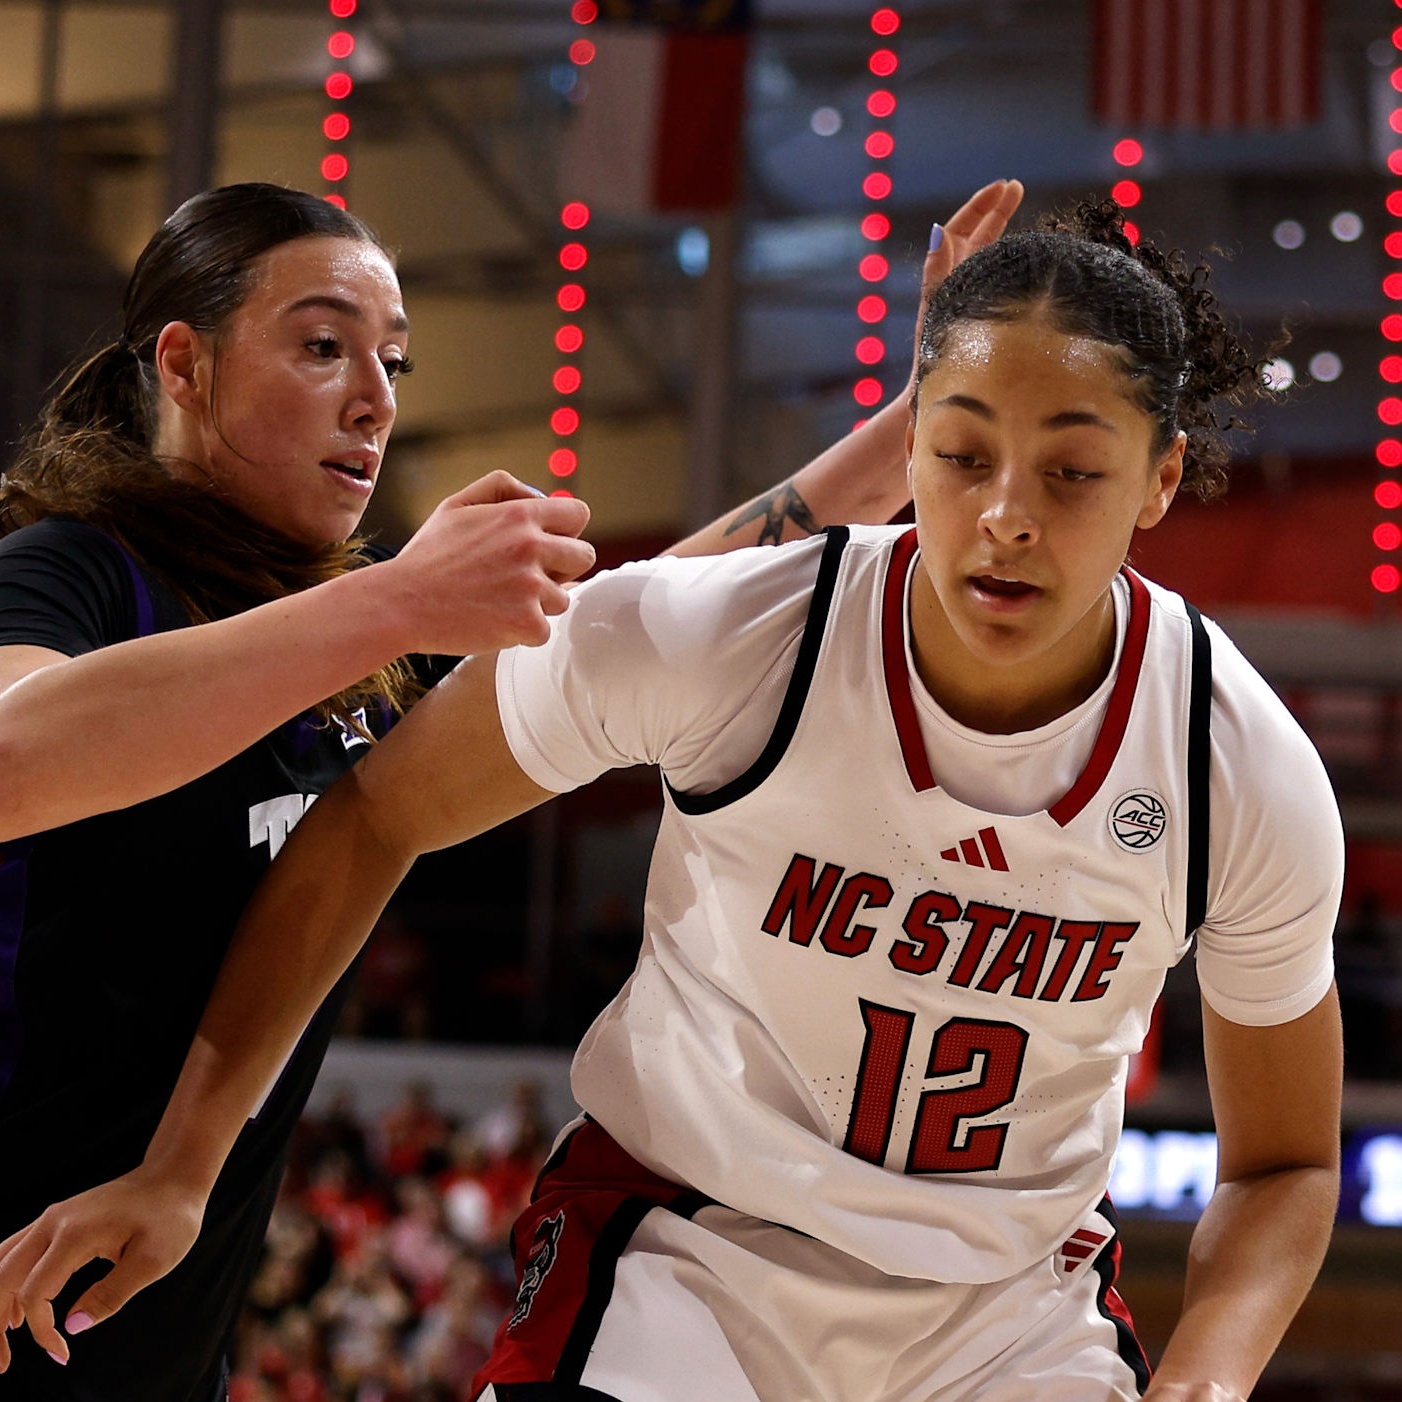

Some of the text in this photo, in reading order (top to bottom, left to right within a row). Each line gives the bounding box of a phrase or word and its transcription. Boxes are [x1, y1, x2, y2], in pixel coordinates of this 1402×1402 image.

[1118, 810, 1166, 828] ACC
[761, 853, 1140, 1003] NC STATE
[842, 997, 1030, 1175] 12
